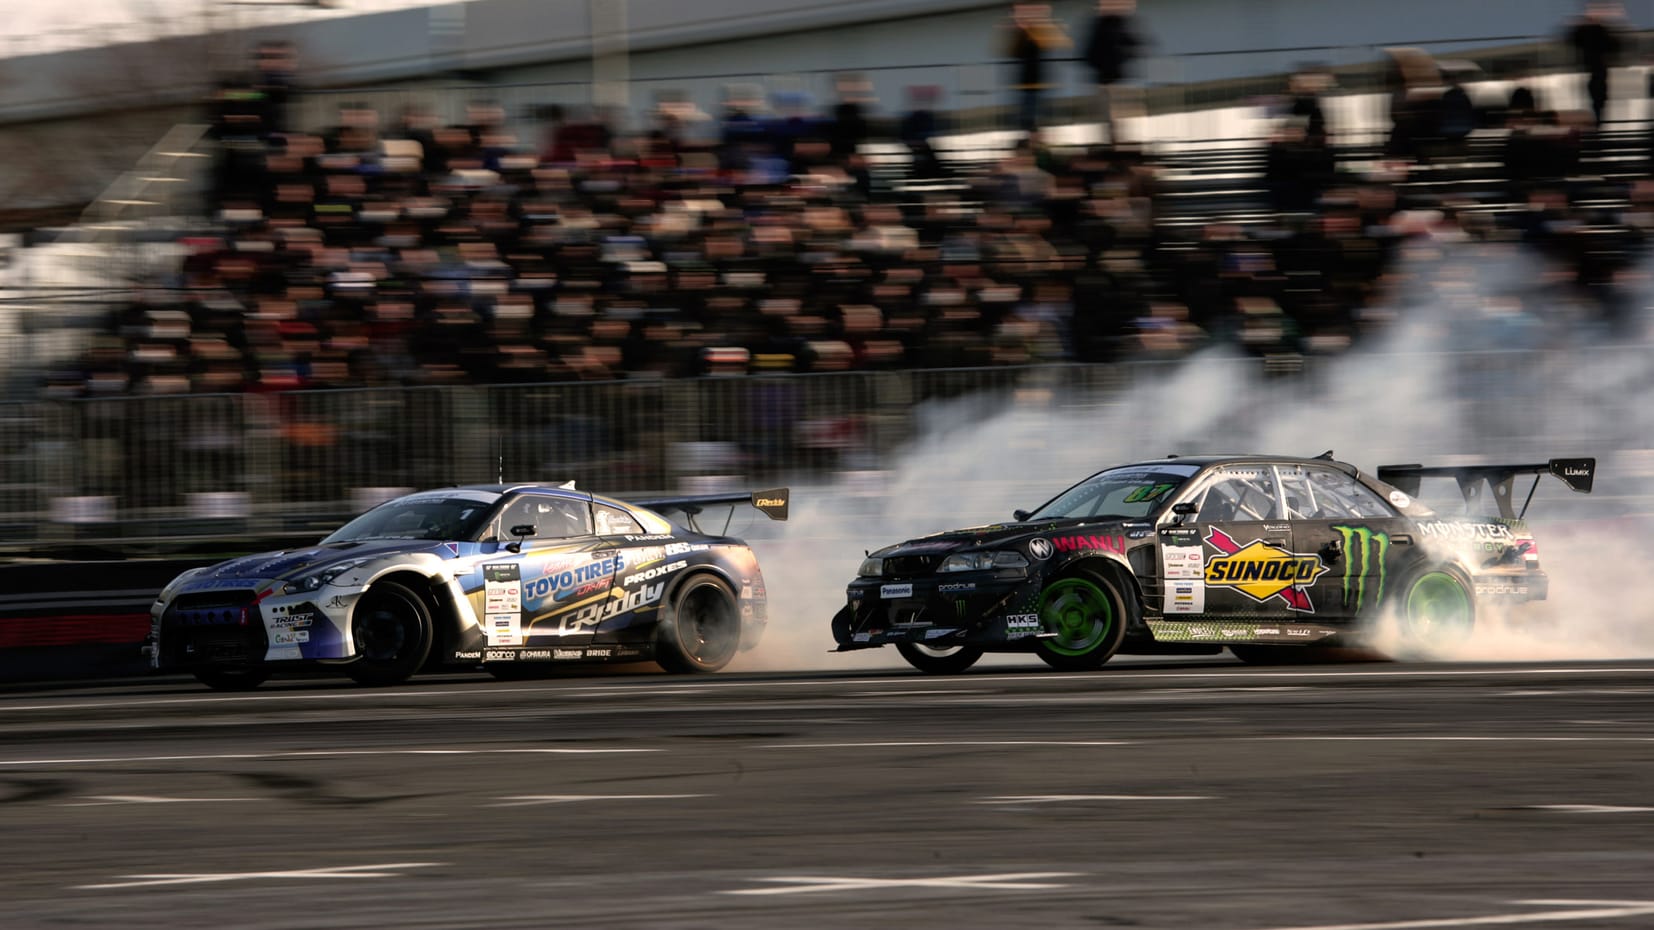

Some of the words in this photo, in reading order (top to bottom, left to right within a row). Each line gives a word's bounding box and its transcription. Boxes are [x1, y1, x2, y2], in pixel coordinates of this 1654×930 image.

[1417, 520, 1513, 540] MONSTER
[525, 571, 573, 598] TOYO
[575, 555, 625, 583] TIRES
[624, 559, 688, 586] PROXES
[1208, 560, 1316, 581] SUNOCO
[881, 585, 912, 596] Panasonic
[558, 581, 665, 637] GReddy
[1007, 614, 1037, 624] HKS
